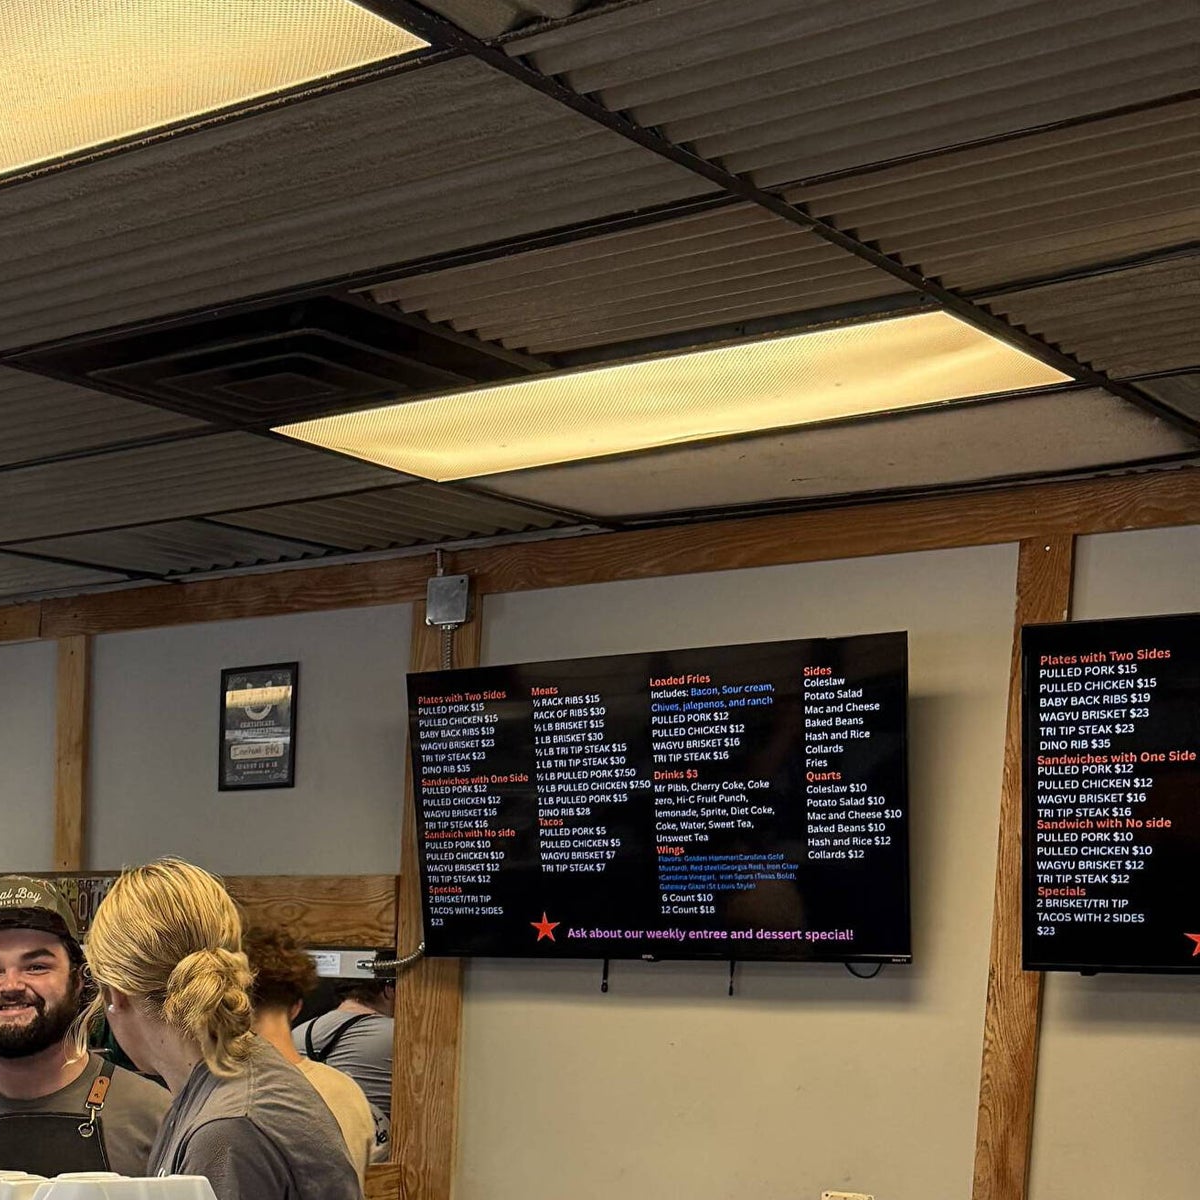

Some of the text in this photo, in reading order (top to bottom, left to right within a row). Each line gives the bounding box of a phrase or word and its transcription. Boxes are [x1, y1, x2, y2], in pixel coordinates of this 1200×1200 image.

[1040, 648, 1170, 665] Plates with Two Sides
[804, 666, 831, 675] Sides
[1039, 663, 1137, 678] PULLED PORK $15
[650, 673, 710, 686] Loaded Fries
[804, 677, 844, 686] Coleslaw
[1039, 677, 1156, 692] PULLED CHICKEN $15
[804, 689, 862, 700] Potato Salad
[1040, 693, 1150, 707] BABY BACK RIBS $19
[804, 702, 879, 713] Mac and Cheese
[652, 711, 728, 724] PULLED PORK $12
[1039, 708, 1149, 721] WAGYU BRISKET $23
[805, 716, 863, 727] Baked Beans
[652, 724, 744, 737] PULLED CHICKEN $12
[1039, 723, 1134, 735] TRI TIP STEAK $23
[805, 729, 870, 740] Hash and Rice
[805, 744, 843, 753] Collards
[1040, 738, 1110, 749] DINO RIB $35
[806, 758, 827, 766] Fries
[1037, 750, 1196, 764] Sandwiches with One Side
[654, 769, 698, 779] Drinks $3
[1038, 763, 1133, 775] PULLED PORK $12
[806, 771, 841, 780] Quarts
[806, 783, 866, 793] Coleslaw $10
[1038, 778, 1152, 789] PULLED CHICKEN $12
[806, 796, 884, 806] Potato Salad $10
[1037, 792, 1146, 803] WAGYU BRISKET $16
[847, 810, 882, 818] Cheese
[884, 809, 901, 818] $10
[1037, 807, 1131, 817] TRI TIP STEAK $16
[807, 822, 885, 832] Baked Beans $10
[1037, 819, 1093, 828] Sandwich
[1096, 818, 1122, 827] with
[1126, 818, 1142, 827] No
[852, 837, 872, 845] Rice
[874, 836, 890, 844] $12
[1037, 832, 1133, 841] PULLED PORK $10
[808, 849, 864, 858] Collards $12
[1037, 845, 1152, 855] PULLED CHICKEN $10
[1036, 860, 1143, 869] WAGYU BRISKET $12
[1036, 874, 1052, 882] TRI
[1074, 874, 1108, 883] STEAK
[1110, 874, 1129, 883] $12
[15, 886, 42, 902] Boy
[1038, 886, 1085, 895] Specials
[1036, 898, 1128, 907] 2 BRISKET/TRI TIP
[1038, 912, 1144, 922] TACOS WITH 2 SIDES
[567, 928, 587, 937] Ask
[589, 929, 622, 937] about
[646, 929, 685, 938] weekly
[756, 931, 802, 939] dessert
[805, 929, 853, 939] special!
[1037, 926, 1055, 935] $23
